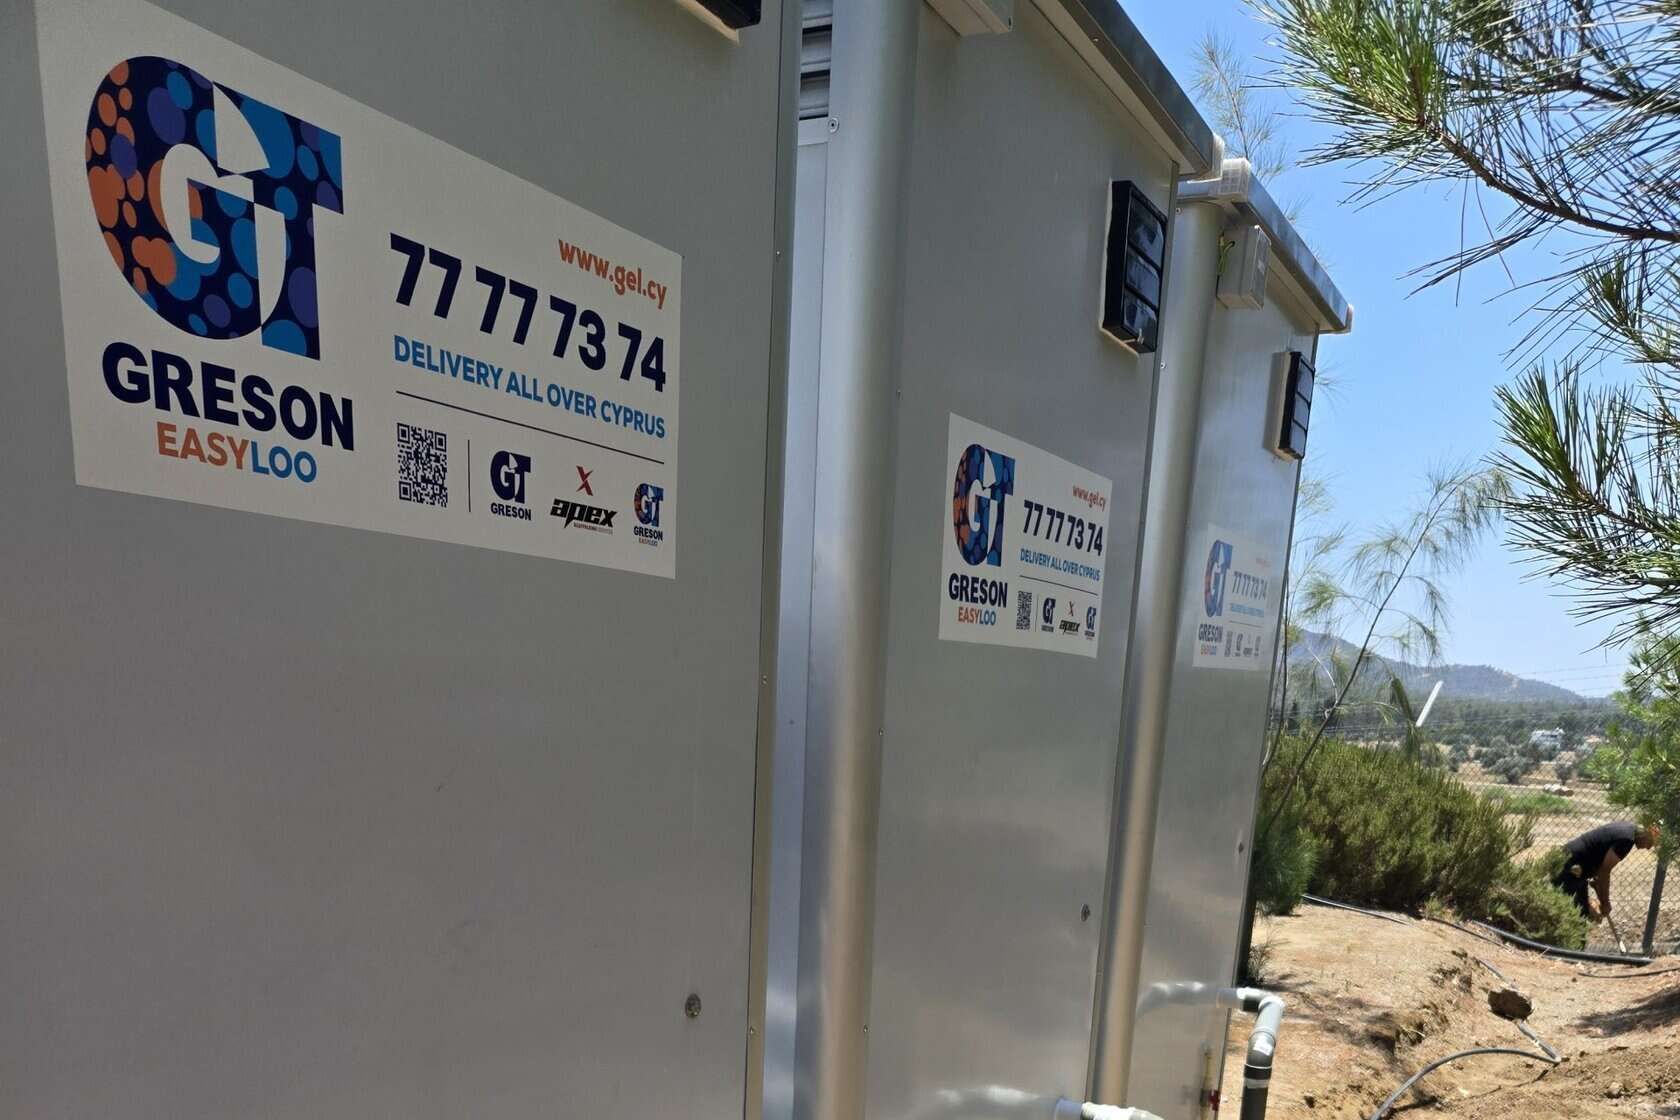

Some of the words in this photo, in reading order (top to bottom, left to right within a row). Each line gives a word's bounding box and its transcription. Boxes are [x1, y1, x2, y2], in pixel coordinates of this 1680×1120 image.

[558, 238, 667, 310] www.gel.cy
[390, 232, 462, 319] 77
[475, 265, 538, 345] 77
[550, 295, 606, 371] 73
[618, 322, 666, 393] 74
[102, 341, 355, 451] GRESON
[394, 334, 503, 389] DELIVERY
[505, 371, 543, 403] ALL
[546, 383, 596, 418] OVER
[601, 400, 665, 438] CYPRUS
[156, 421, 317, 483] EASYLOO
[490, 502, 532, 521] GRESON
[550, 498, 618, 529] apex
[1023, 499, 1044, 536] 77
[1046, 506, 1065, 543] 77
[1066, 514, 1084, 550] 73
[1086, 521, 1103, 556] 74
[633, 525, 663, 541] GRESON
[1020, 548, 1051, 567] DELIVERY
[1050, 556, 1062, 571] ALL
[1062, 559, 1079, 575] OVER
[1079, 565, 1101, 581] CYPRUS
[948, 572, 1008, 608] GRESON
[958, 606, 997, 626] EASYLOO
[1199, 623, 1224, 643] GRESON
